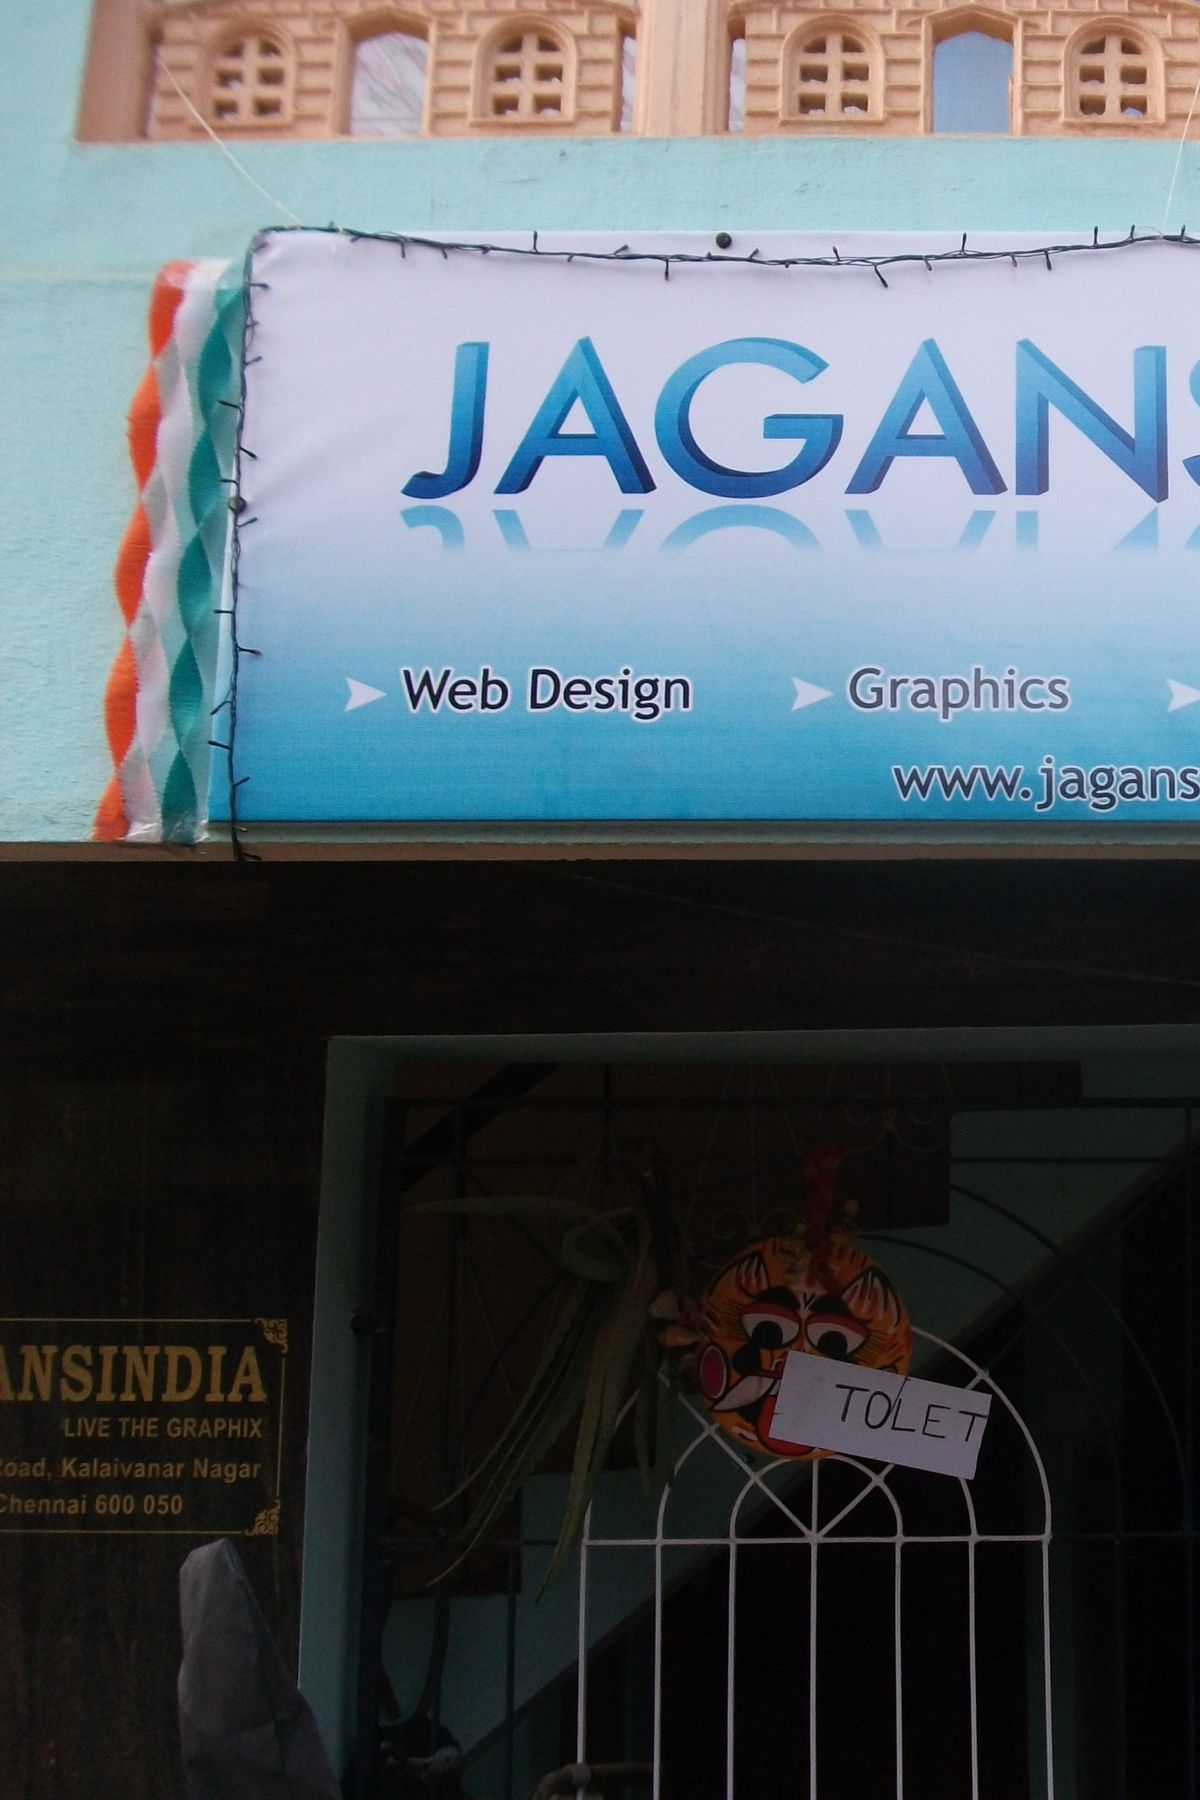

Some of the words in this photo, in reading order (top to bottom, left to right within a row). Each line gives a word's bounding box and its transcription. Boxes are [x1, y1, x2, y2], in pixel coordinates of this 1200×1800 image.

[402, 668, 510, 711] Web
[529, 669, 693, 718] Design
[848, 666, 1070, 719] Graphics
[64, 1417, 110, 1437] LIVE
[118, 1417, 159, 1438] THE
[167, 1417, 263, 1438] GRAPHIX
[0, 1457, 52, 1481] oad,
[61, 1457, 185, 1479] Kalaivanar
[193, 1458, 260, 1484] Nagar
[95, 1494, 134, 1515] 600
[143, 1495, 183, 1516] 050
